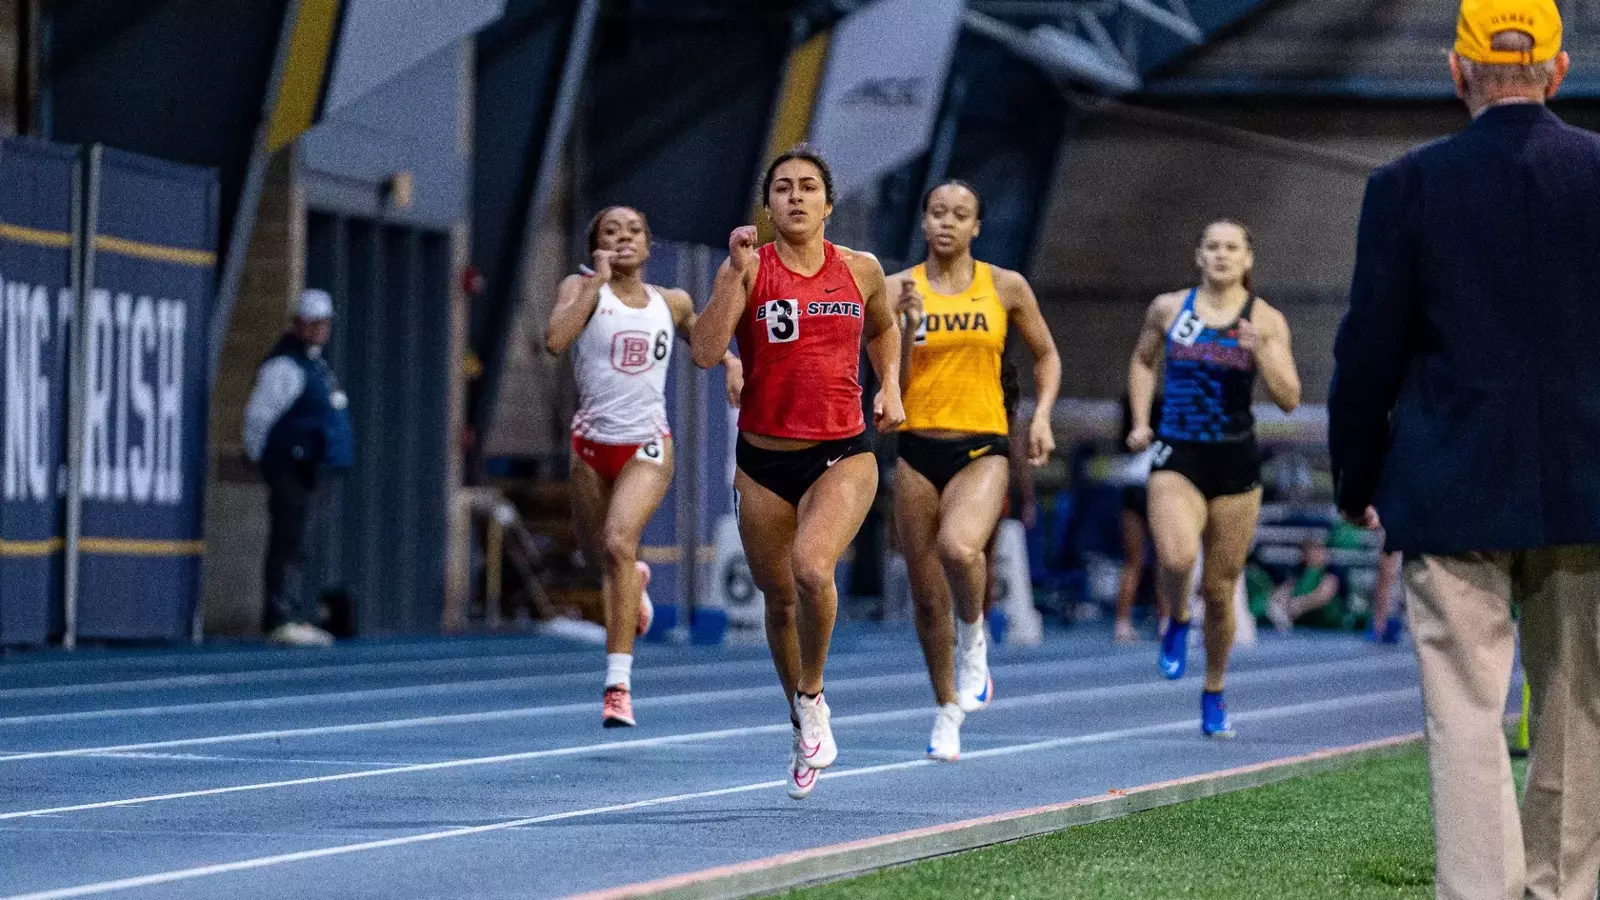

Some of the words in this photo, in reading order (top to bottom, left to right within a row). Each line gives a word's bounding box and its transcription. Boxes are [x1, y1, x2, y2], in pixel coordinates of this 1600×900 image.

[770, 299, 795, 340] 3
[808, 302, 860, 318] STATE
[925, 311, 989, 332] OWA
[1178, 316, 1198, 338] 5
[620, 337, 649, 366] B
[654, 330, 669, 360] 6
